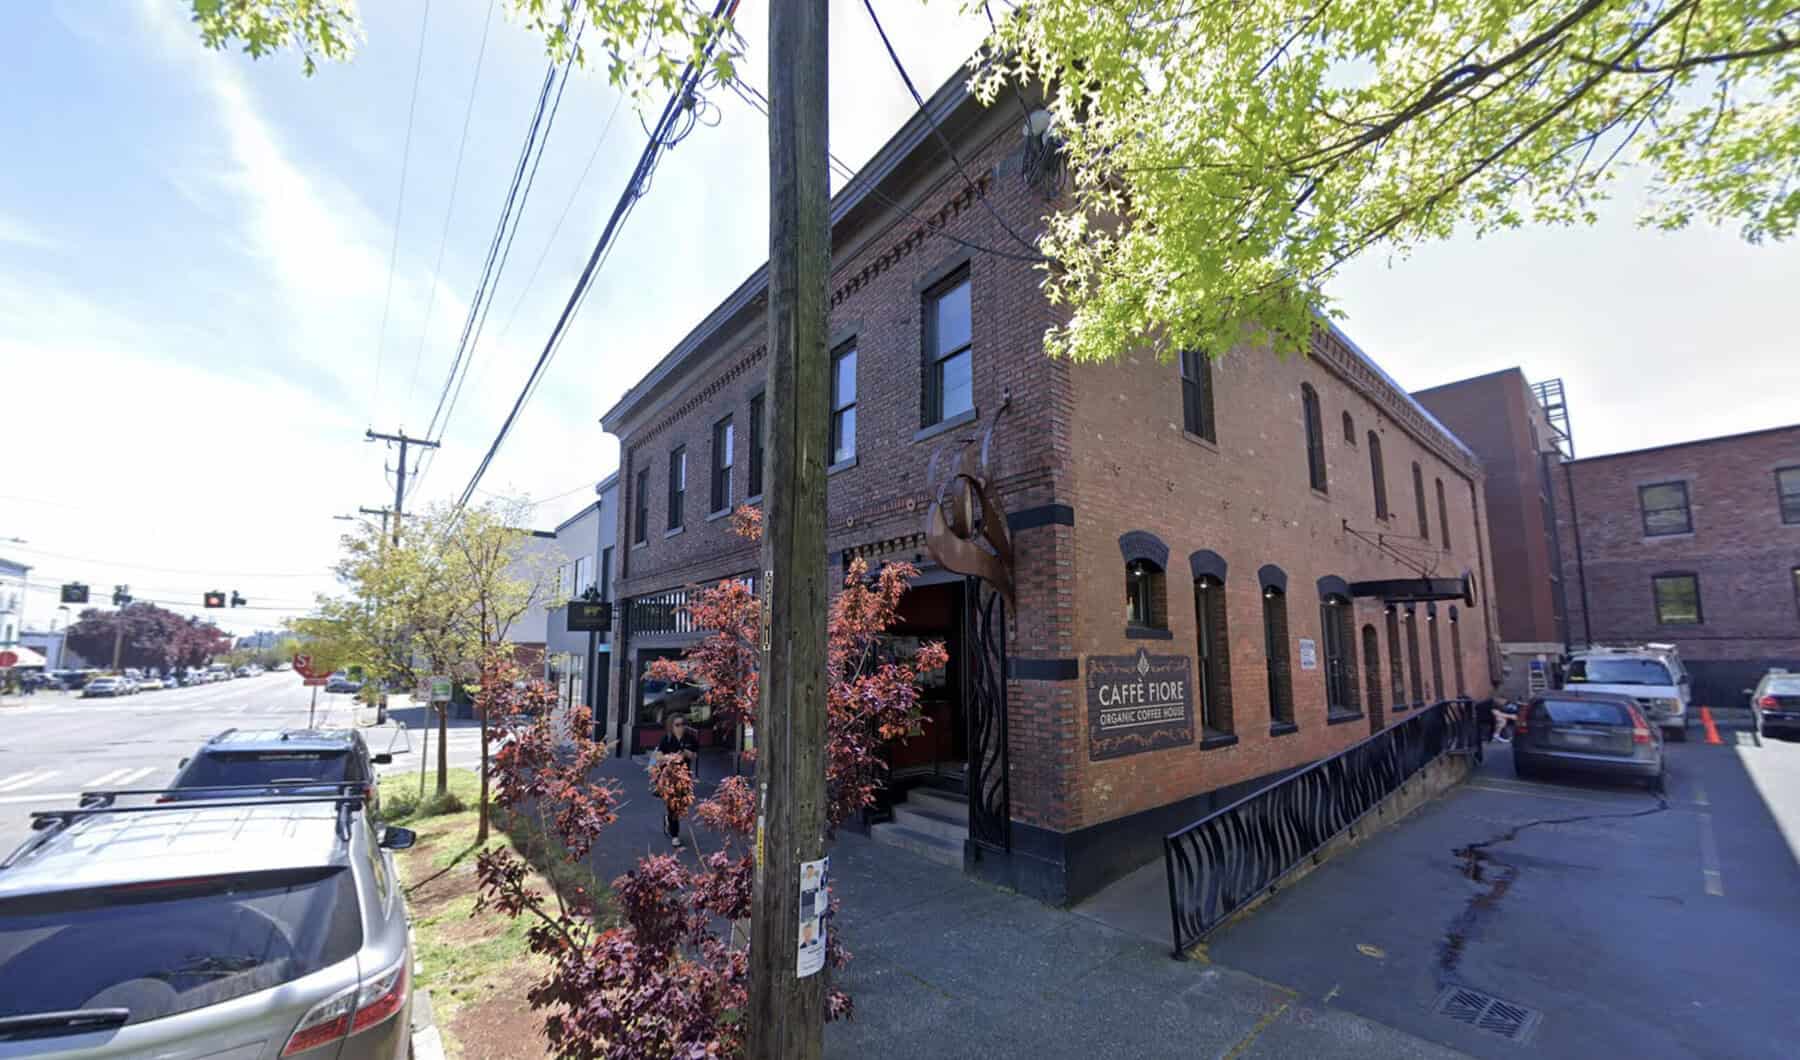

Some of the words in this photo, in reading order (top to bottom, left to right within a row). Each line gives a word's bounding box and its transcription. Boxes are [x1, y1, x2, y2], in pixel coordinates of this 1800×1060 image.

[1099, 677, 1145, 706] CAFFÈ
[1149, 681, 1184, 702] FIORE
[1100, 711, 1136, 726] ORGANIC
[1137, 709, 1161, 720] COFFEE
[1163, 706, 1184, 719] HOUSE
